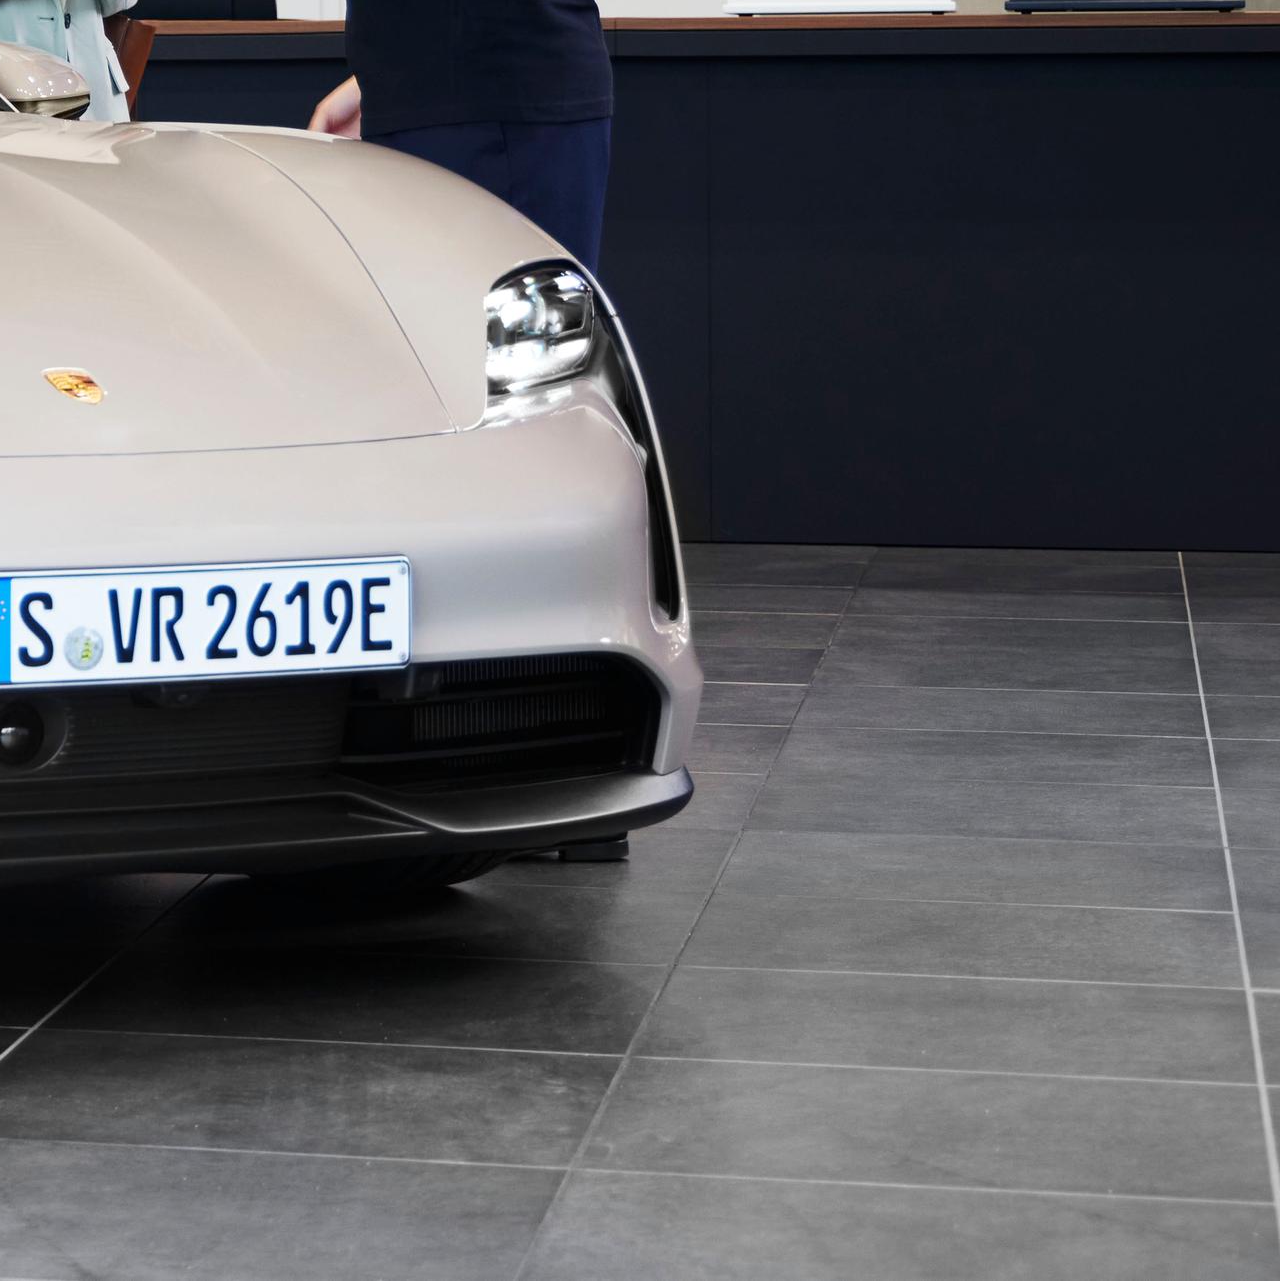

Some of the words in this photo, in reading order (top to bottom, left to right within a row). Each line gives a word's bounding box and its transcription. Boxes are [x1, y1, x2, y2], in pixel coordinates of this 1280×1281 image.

[18, 591, 54, 667] S
[107, 586, 185, 663] VR
[205, 576, 393, 659] 2619E
